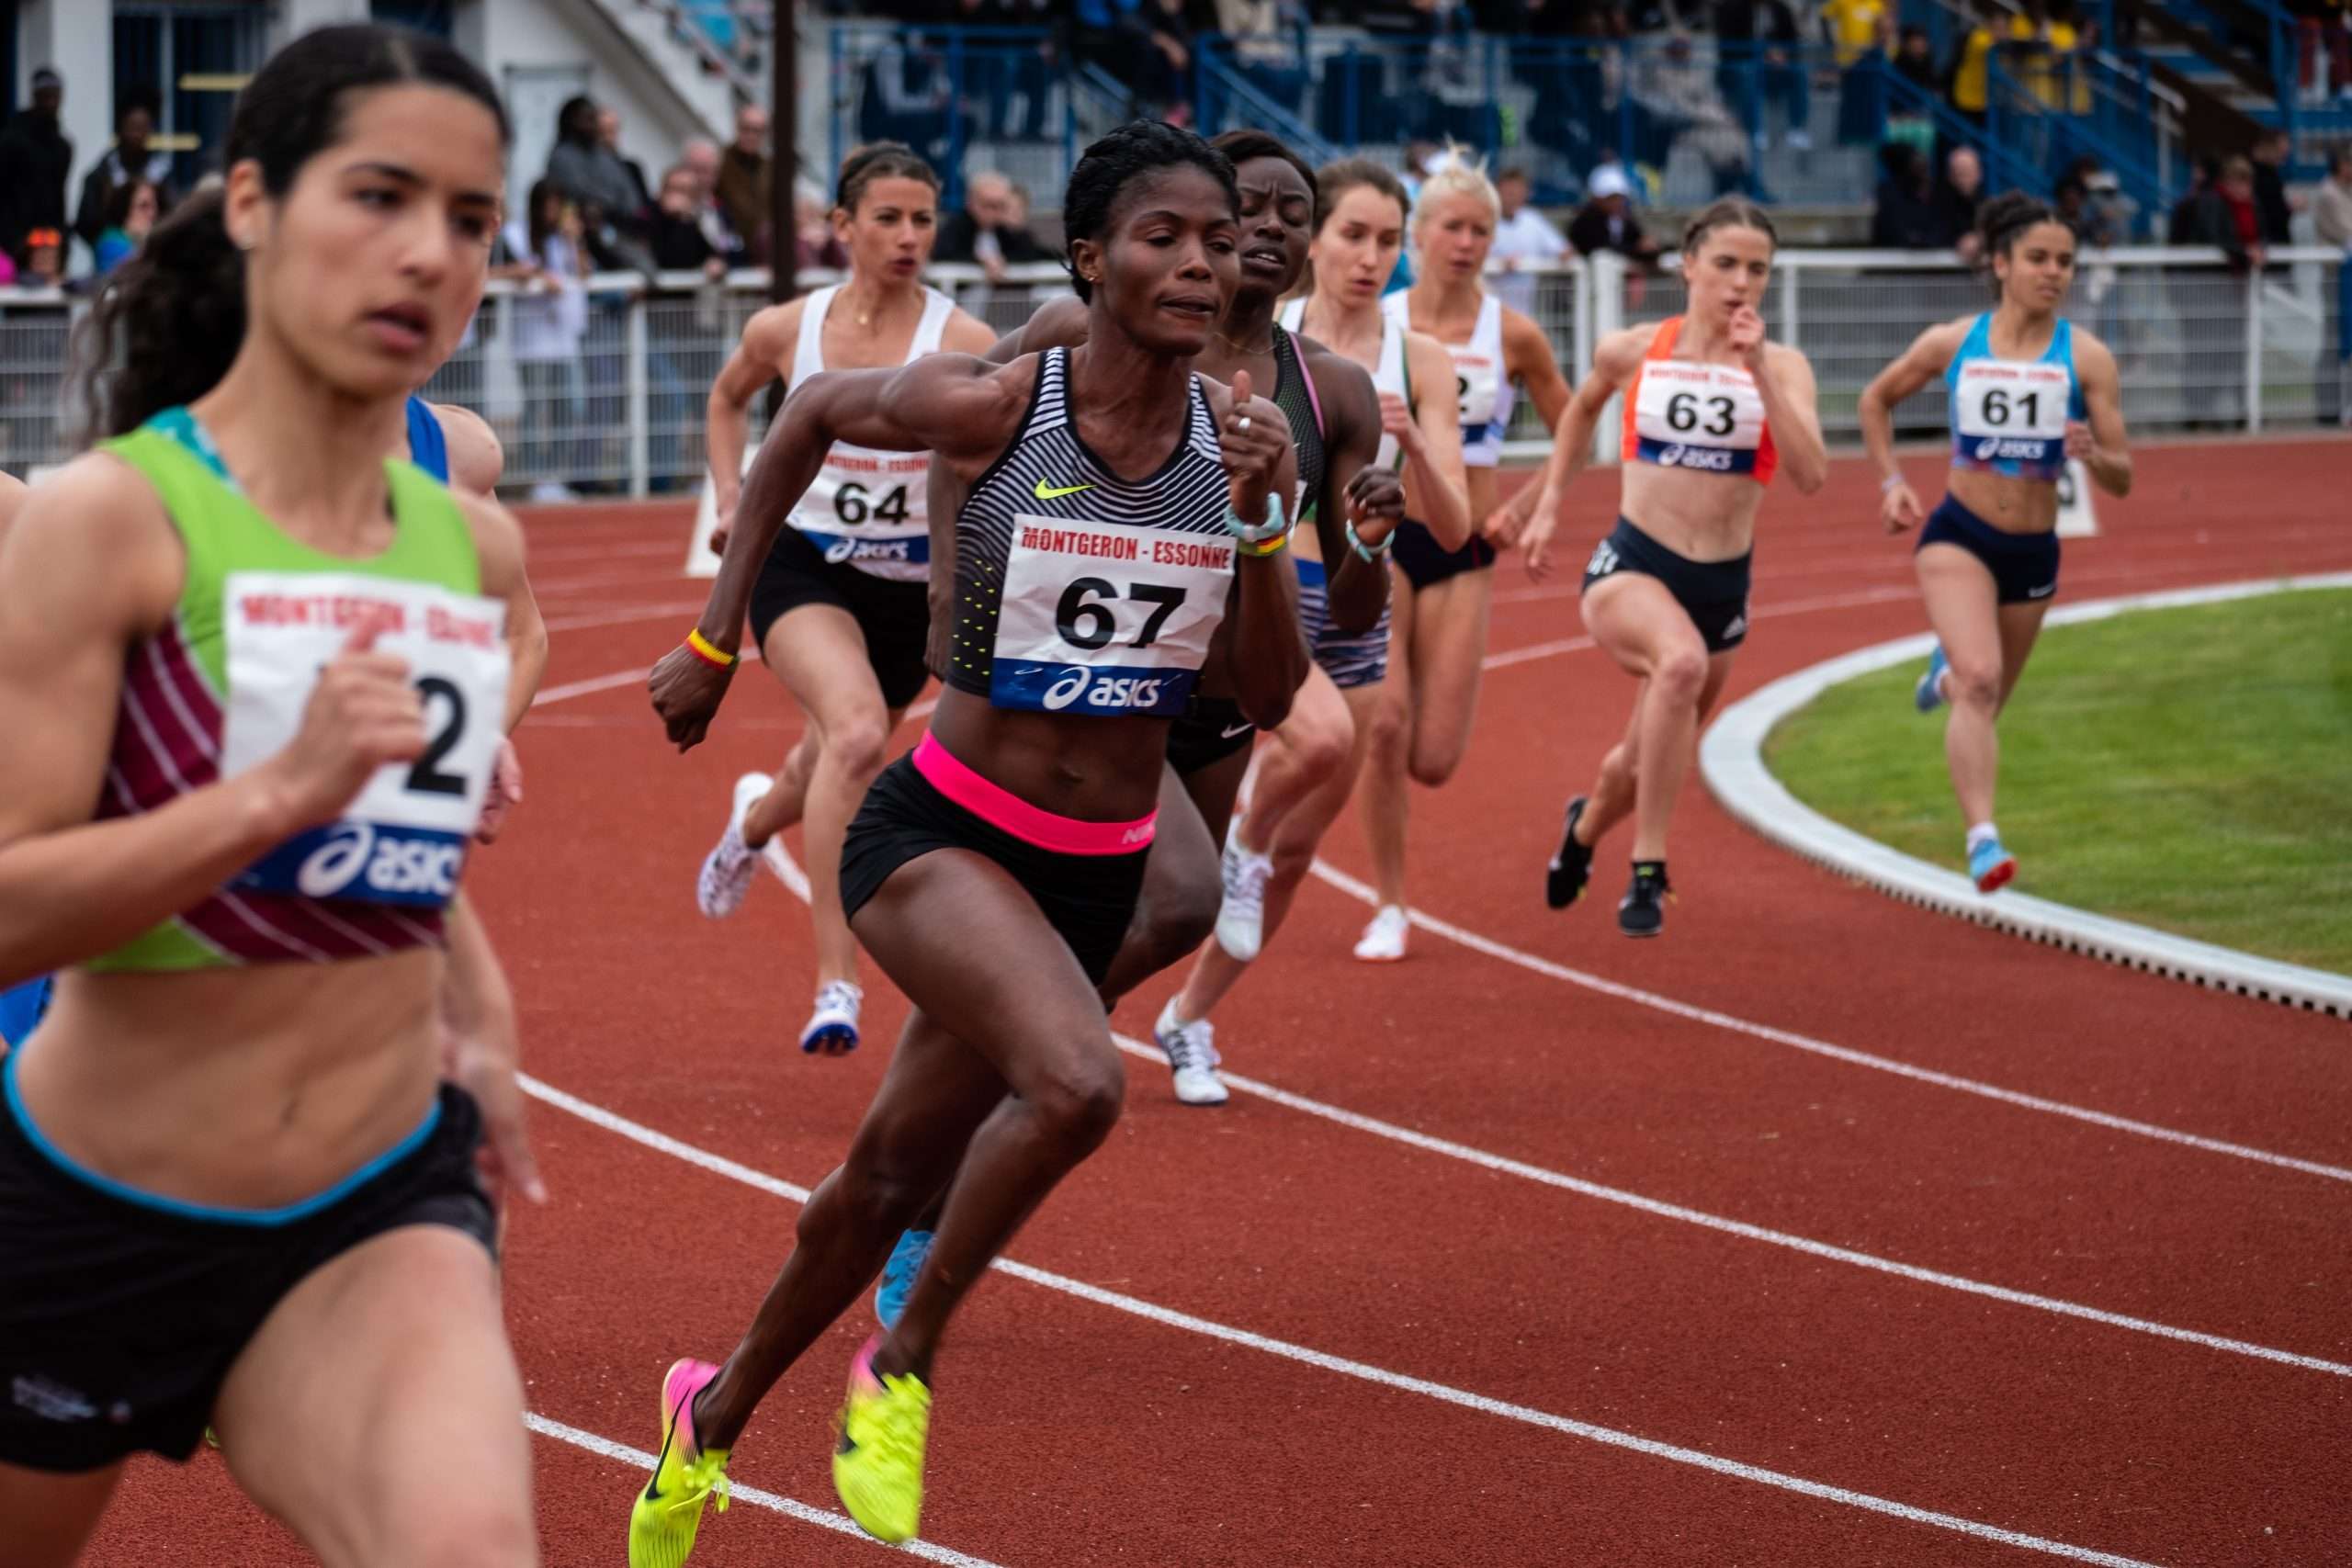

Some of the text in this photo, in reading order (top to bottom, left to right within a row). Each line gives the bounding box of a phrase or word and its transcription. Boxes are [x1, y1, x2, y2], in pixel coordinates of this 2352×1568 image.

[1667, 393, 1736, 435] 63
[1982, 389, 2039, 427] 61
[834, 482, 910, 525] 64
[1022, 526, 1138, 560] MONTGERON
[1153, 541, 1230, 570] ESSONNE
[1056, 577, 1187, 650] 67
[1087, 677, 1162, 707] asics
[402, 673, 468, 796] 2
[366, 835, 459, 896] asic
